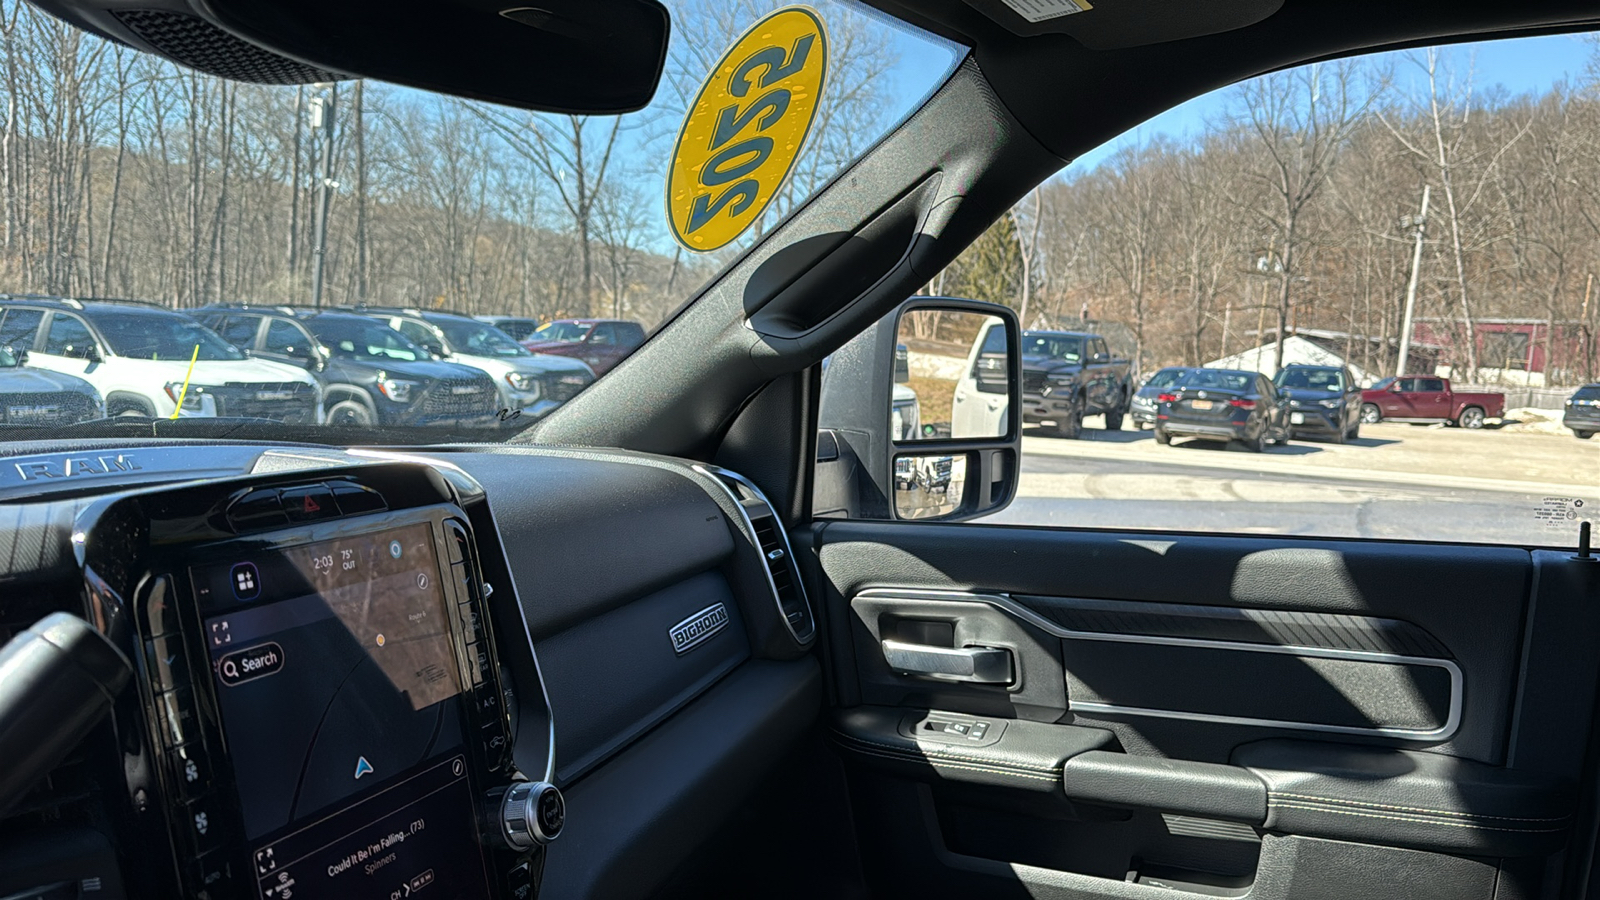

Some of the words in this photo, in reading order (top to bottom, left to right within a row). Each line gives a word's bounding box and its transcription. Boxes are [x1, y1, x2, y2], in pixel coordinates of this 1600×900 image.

[15, 454, 143, 481] RAM
[313, 555, 334, 570] 2:03
[342, 561, 356, 571] OUT
[408, 612, 422, 621] Route
[672, 606, 729, 648] BIGHORN
[241, 651, 278, 672] Search
[327, 856, 352, 877] Could
[351, 853, 358, 865] It
[357, 849, 368, 861] Be
[367, 844, 381, 856] I'm
[410, 818, 425, 834] (73)
[364, 852, 397, 876] Spinners
[390, 889, 402, 900] CH
